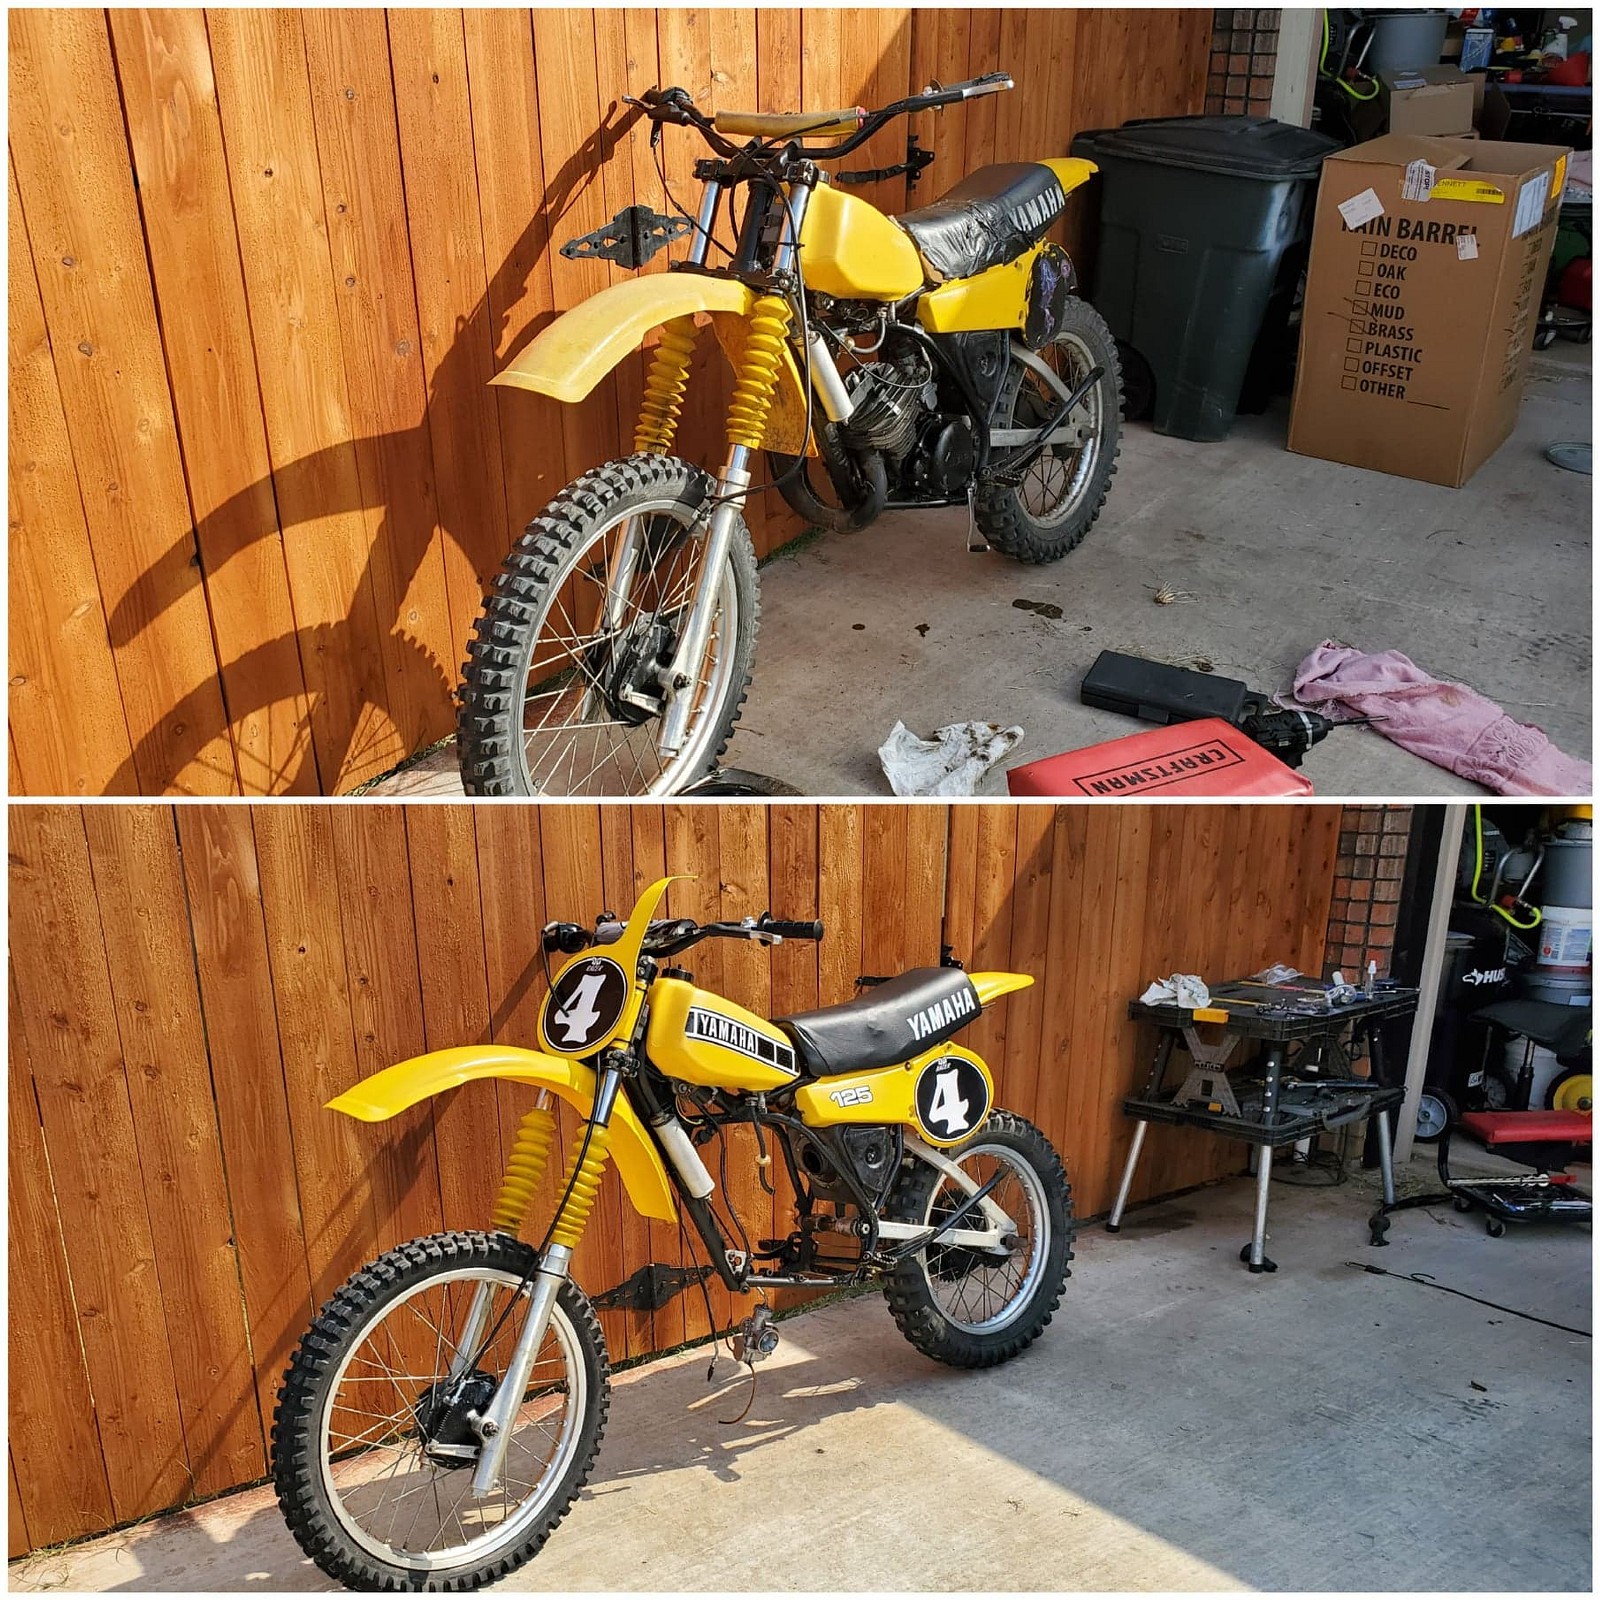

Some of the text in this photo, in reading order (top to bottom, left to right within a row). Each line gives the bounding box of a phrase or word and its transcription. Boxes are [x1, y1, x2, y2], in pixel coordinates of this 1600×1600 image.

[1008, 183, 1065, 231] YAMAHA
[1380, 243, 1417, 261] DECO
[1377, 263, 1407, 280] OAK
[1374, 283, 1400, 299] ECO
[1371, 303, 1404, 320] MUD
[1369, 322, 1414, 341] BRASS
[1365, 342, 1422, 363] PLASTIC
[1362, 361, 1413, 381] OFFSET
[1360, 379, 1405, 399] OTHER
[1090, 748, 1226, 794] CRAFTSMAN
[554, 974, 606, 1042] 4
[907, 987, 975, 1041] YAMAHA
[700, 1014, 757, 1054] YAMAHA
[829, 1086, 873, 1108] 125
[929, 1068, 969, 1134] 4
